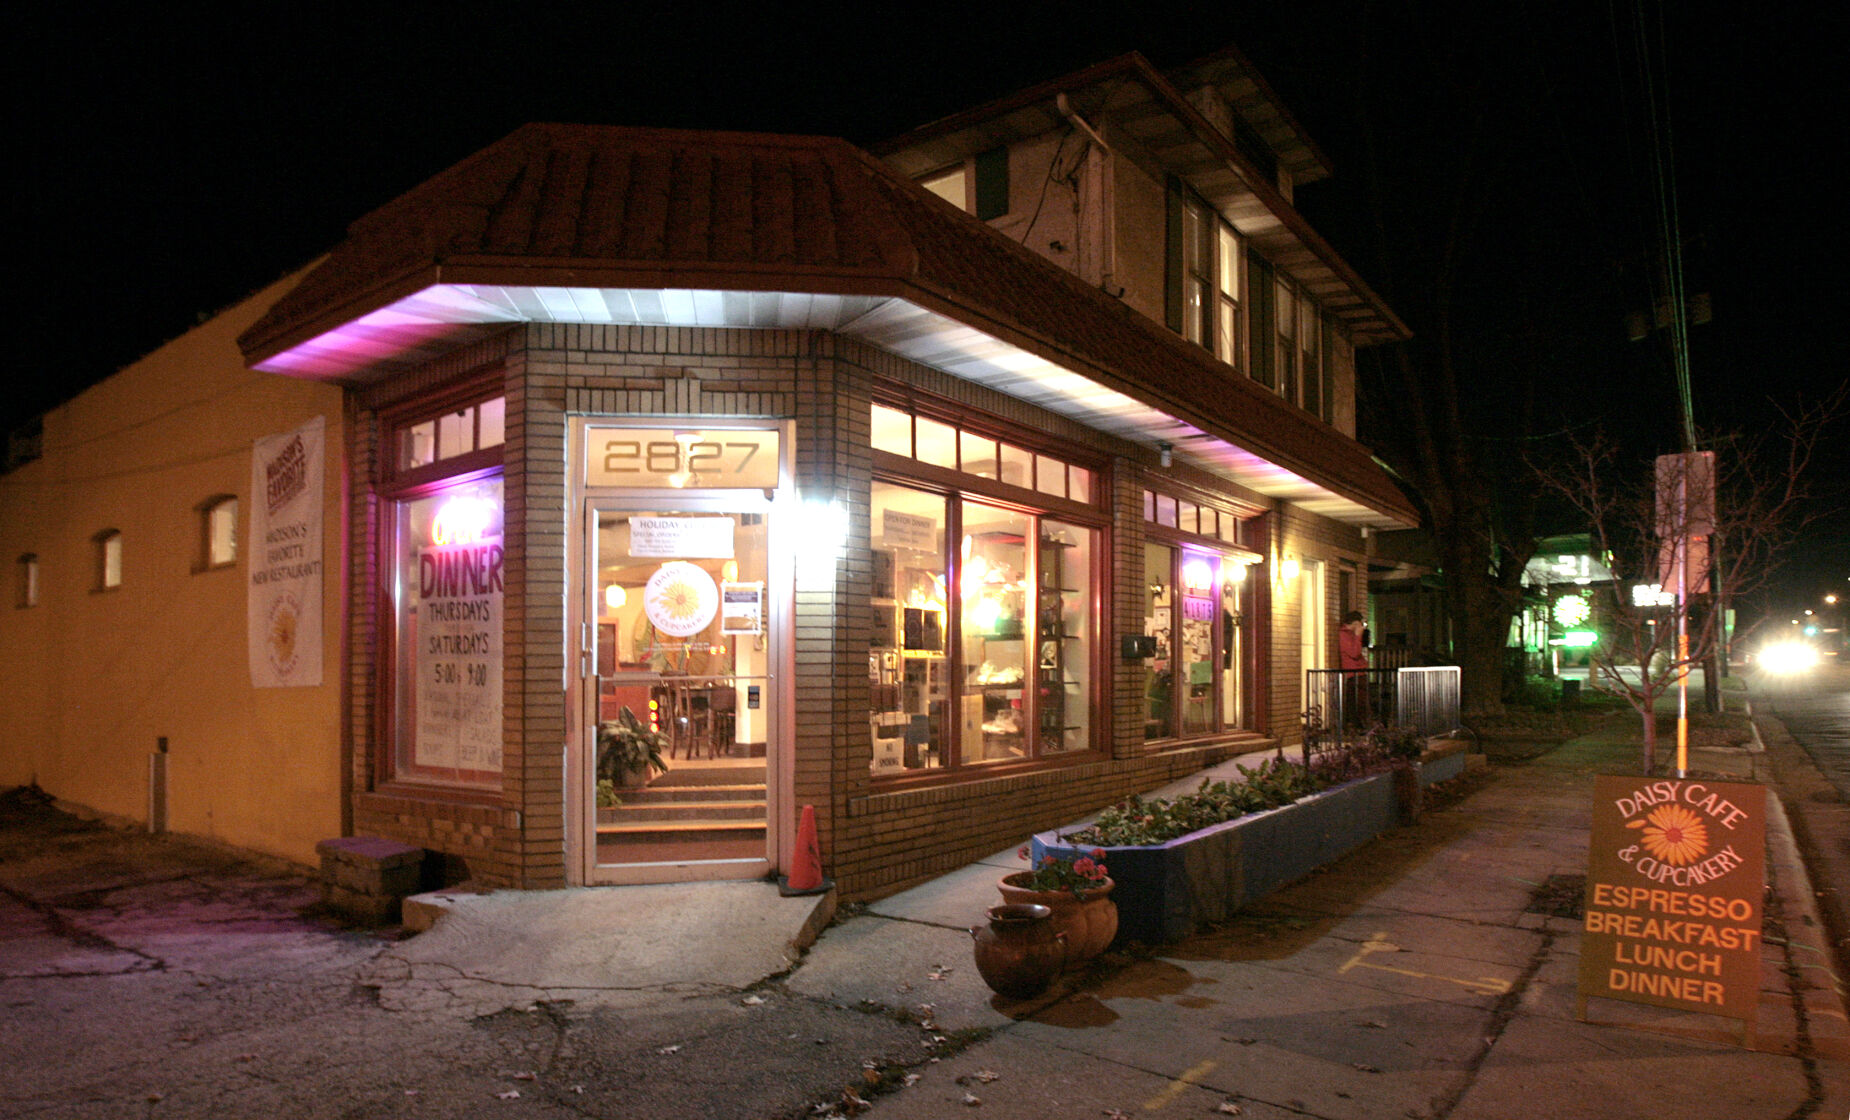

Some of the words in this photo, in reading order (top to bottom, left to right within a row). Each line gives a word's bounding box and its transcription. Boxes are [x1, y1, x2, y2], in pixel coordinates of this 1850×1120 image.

[604, 440, 760, 473] 2827
[420, 545, 504, 599] DINNER
[429, 600, 490, 622] THURSDAYS
[429, 632, 489, 655] SATURDAYS
[1615, 781, 1682, 819] DAISY
[1684, 784, 1748, 831] CAFE
[1617, 844, 1639, 863] &
[1636, 845, 1744, 887] CUPCAKERY
[1593, 883, 1752, 921] ESPRESSO
[1585, 911, 1760, 951] BREAKFAST
[1615, 942, 1722, 976] LUNCH
[1608, 968, 1725, 1005] DINNER
